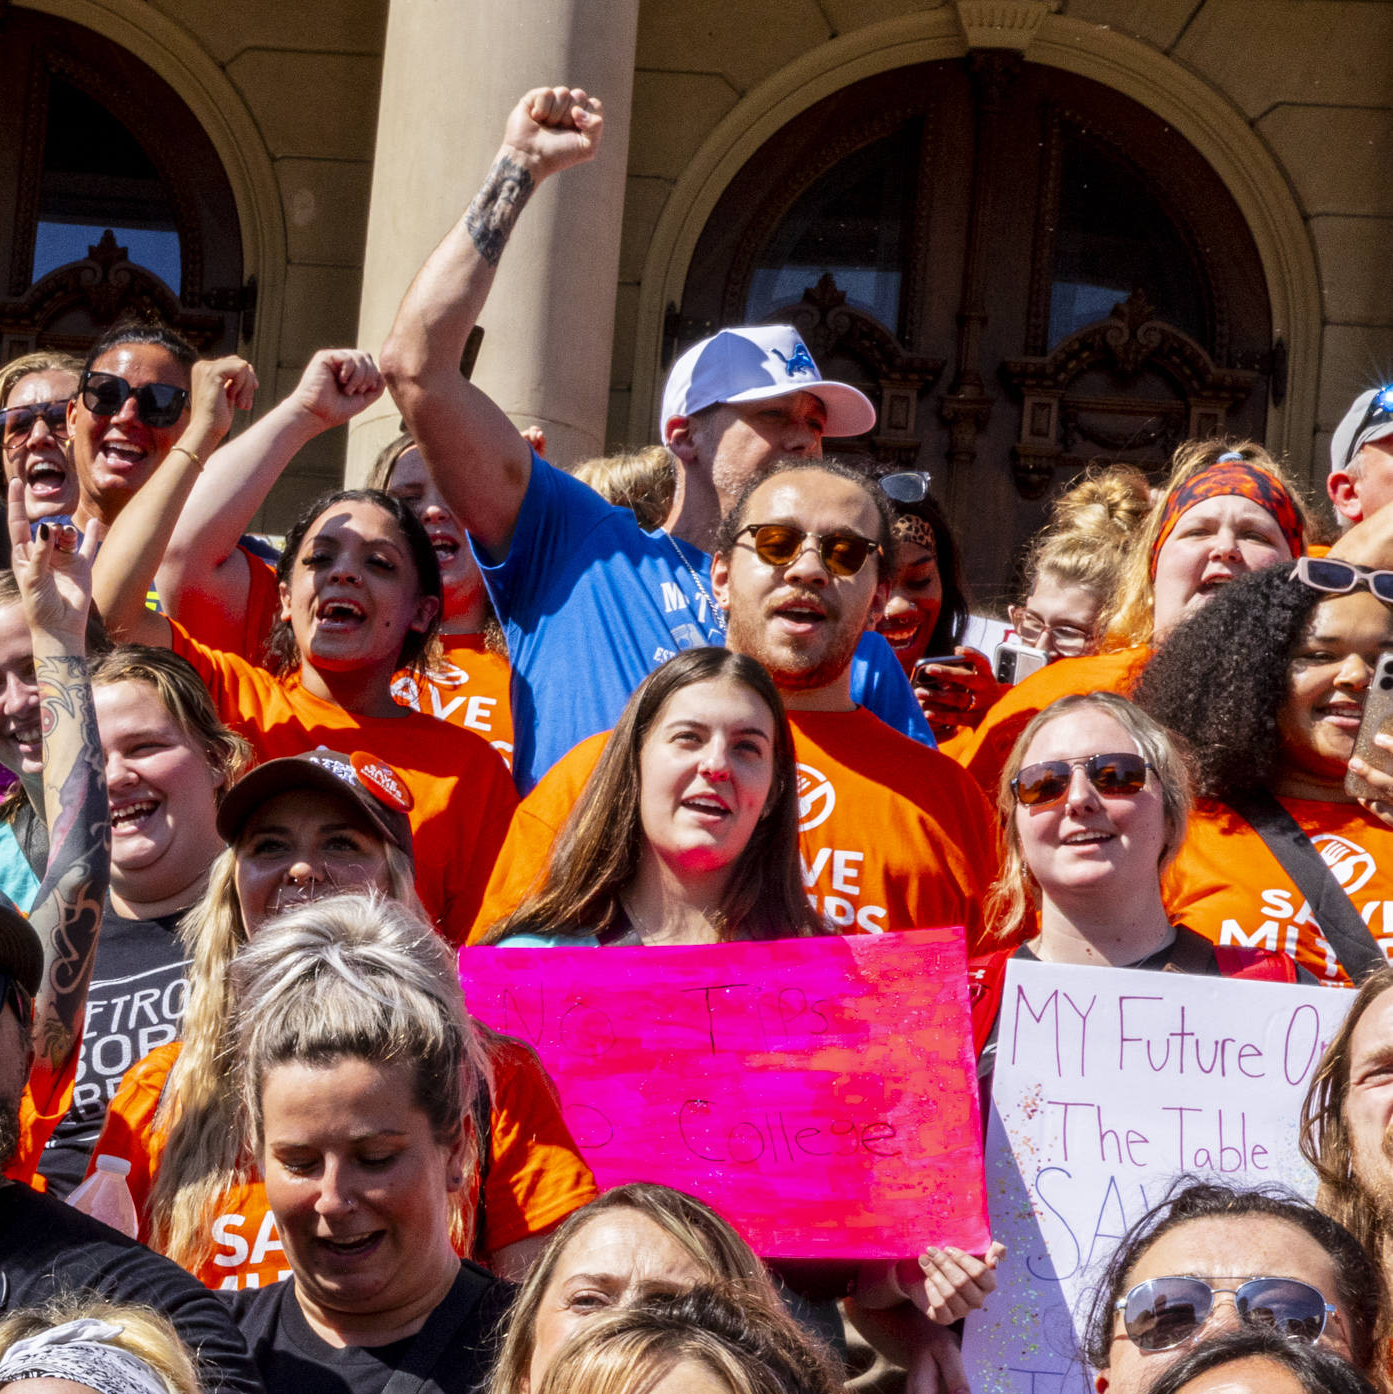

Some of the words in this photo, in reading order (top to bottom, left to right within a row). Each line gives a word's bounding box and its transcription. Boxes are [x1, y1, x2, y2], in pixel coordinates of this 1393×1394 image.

[390, 677, 497, 732] AVE
[1219, 918, 1299, 959] MI
[1012, 984, 1097, 1078] MY
[1118, 995, 1266, 1078] Future
[679, 1099, 902, 1164] College
[1047, 1100, 1150, 1167] The
[1161, 1106, 1270, 1173] Table
